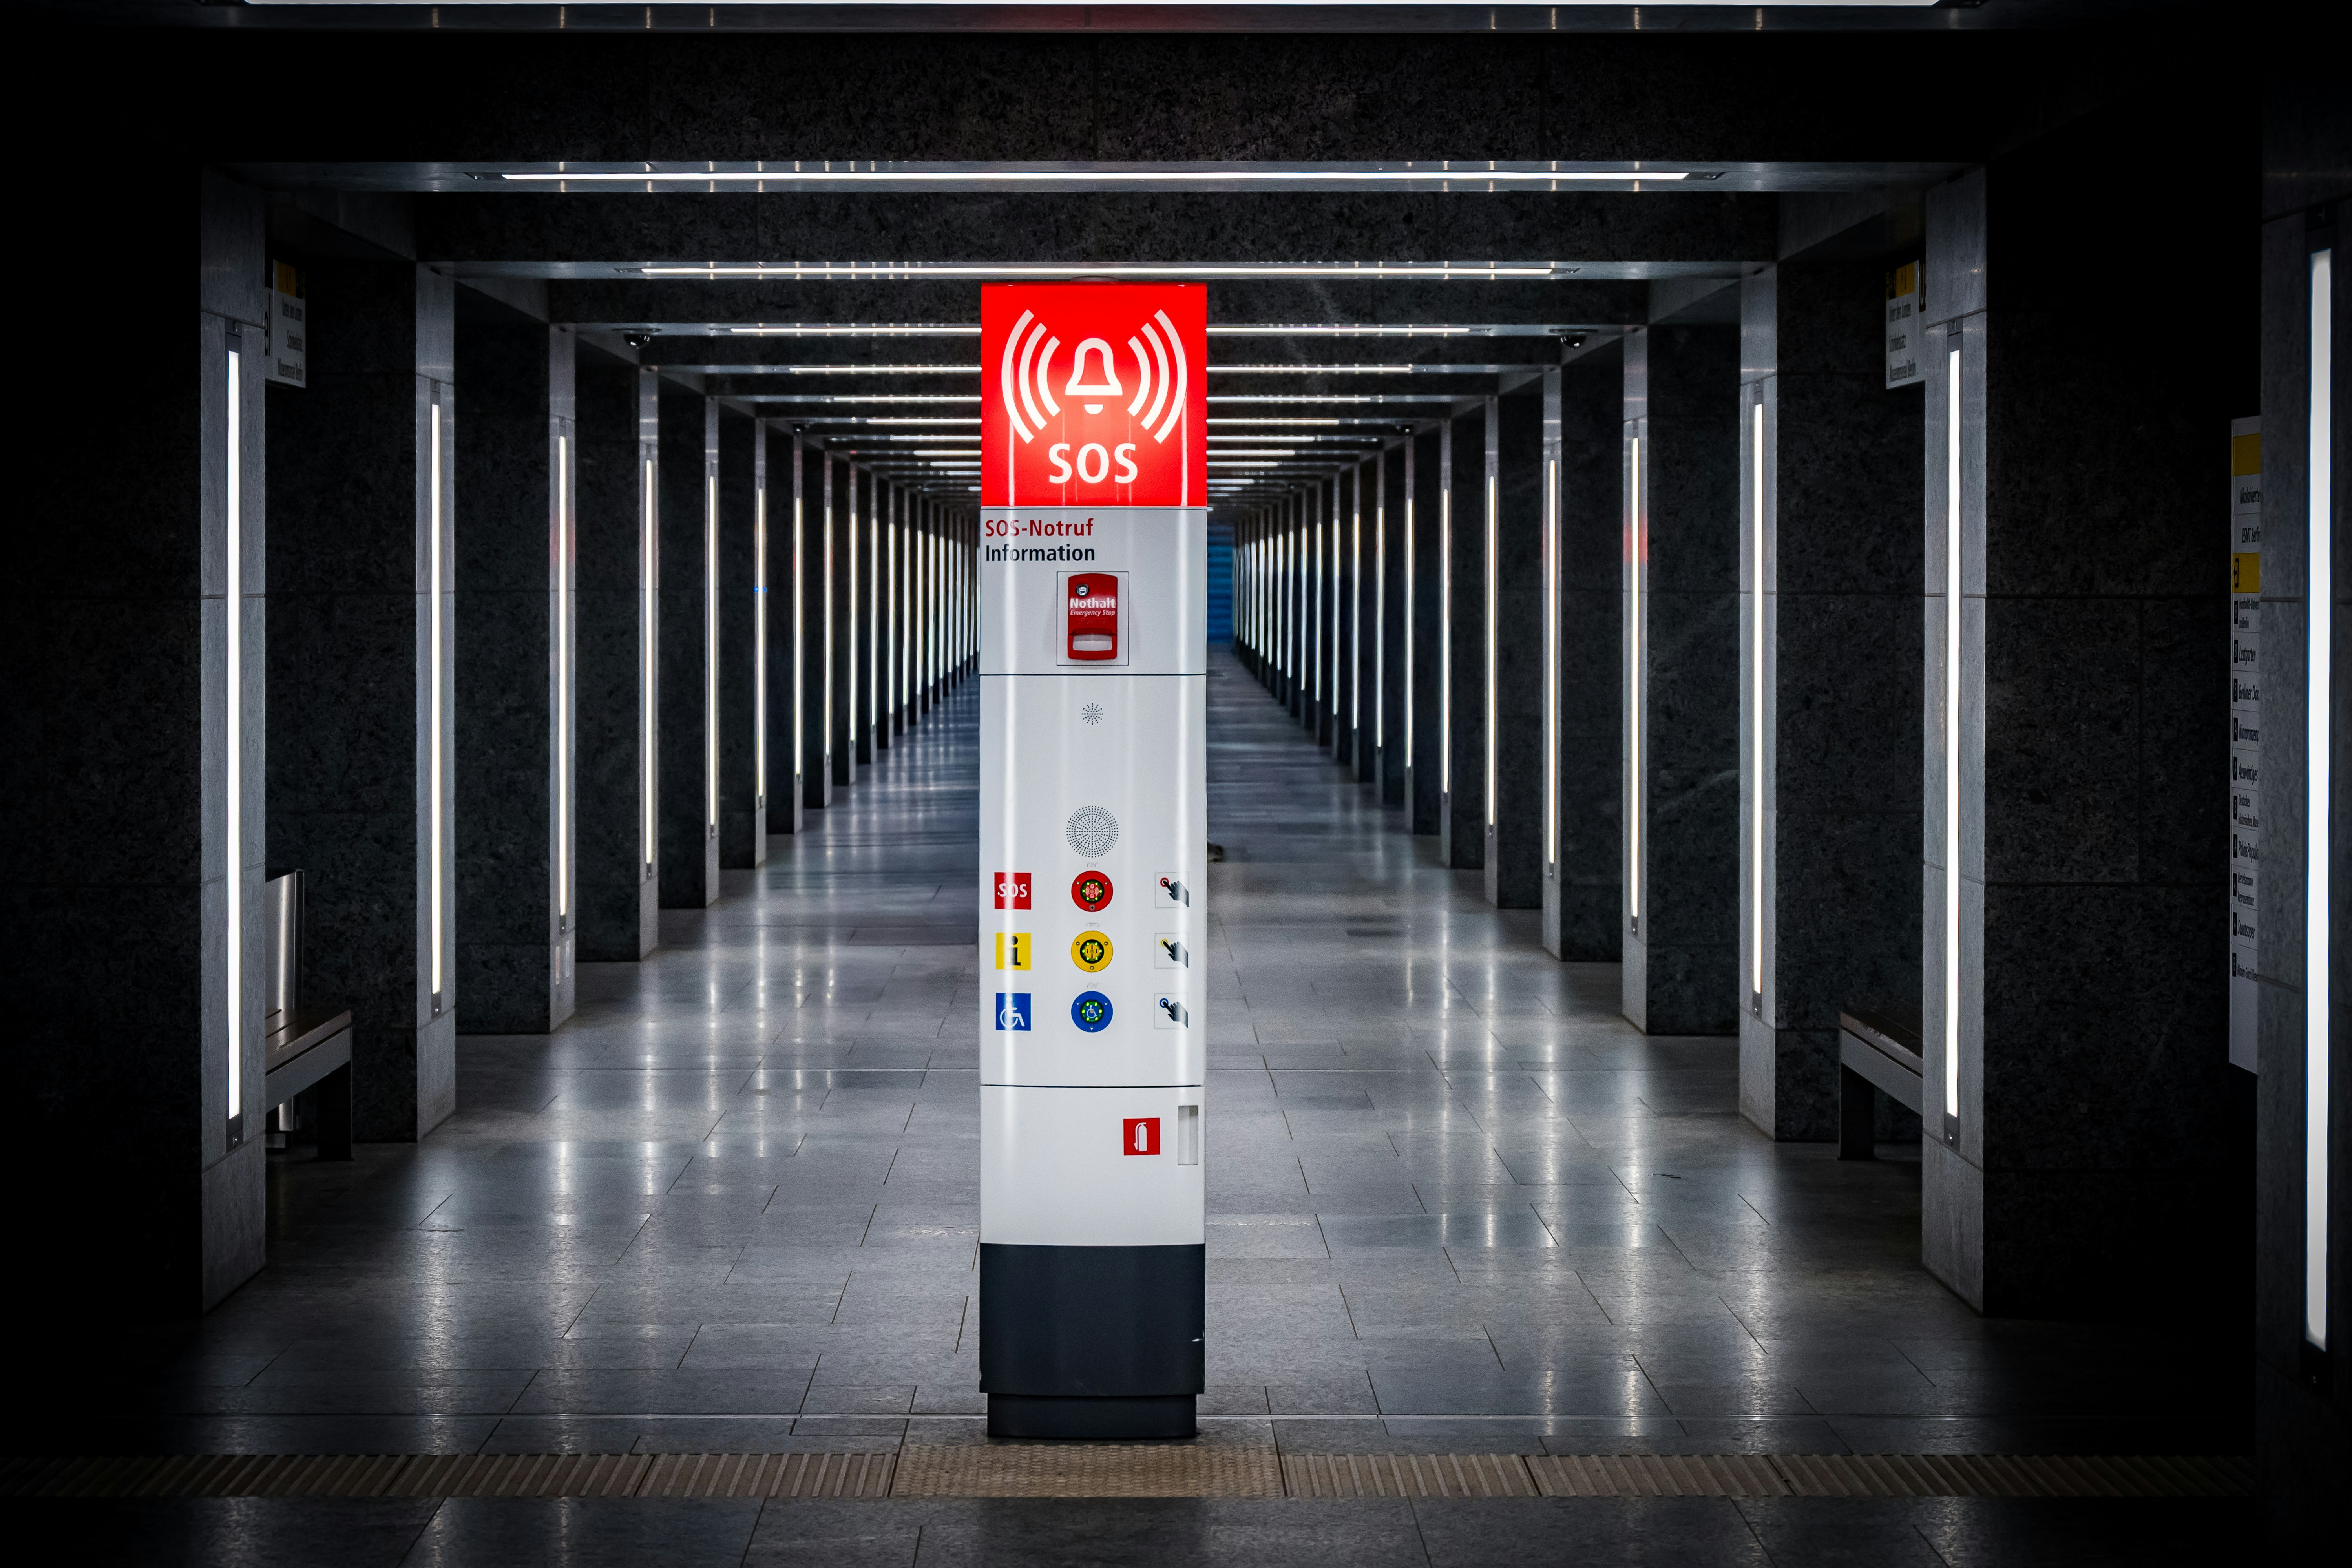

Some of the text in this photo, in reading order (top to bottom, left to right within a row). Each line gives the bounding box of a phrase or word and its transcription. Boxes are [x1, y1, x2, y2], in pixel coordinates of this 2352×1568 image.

[1048, 443, 1138, 484] SOS
[986, 518, 1094, 537] SOS-Notruf
[2242, 527, 2251, 543] ESMT
[986, 544, 1095, 562] Information
[1070, 597, 1116, 608] Nothalt
[2239, 645, 2256, 665] Lustgarten
[2239, 684, 2252, 700] Berliner
[2239, 763, 2258, 785] Auswärtiges
[2239, 794, 2250, 807] Deutsches
[2238, 872, 2253, 887] Bertelsmann
[999, 882, 1027, 898] SOS
[2237, 891, 2254, 907] Repräsentanz
[2238, 920, 2255, 942] Staatsoper
